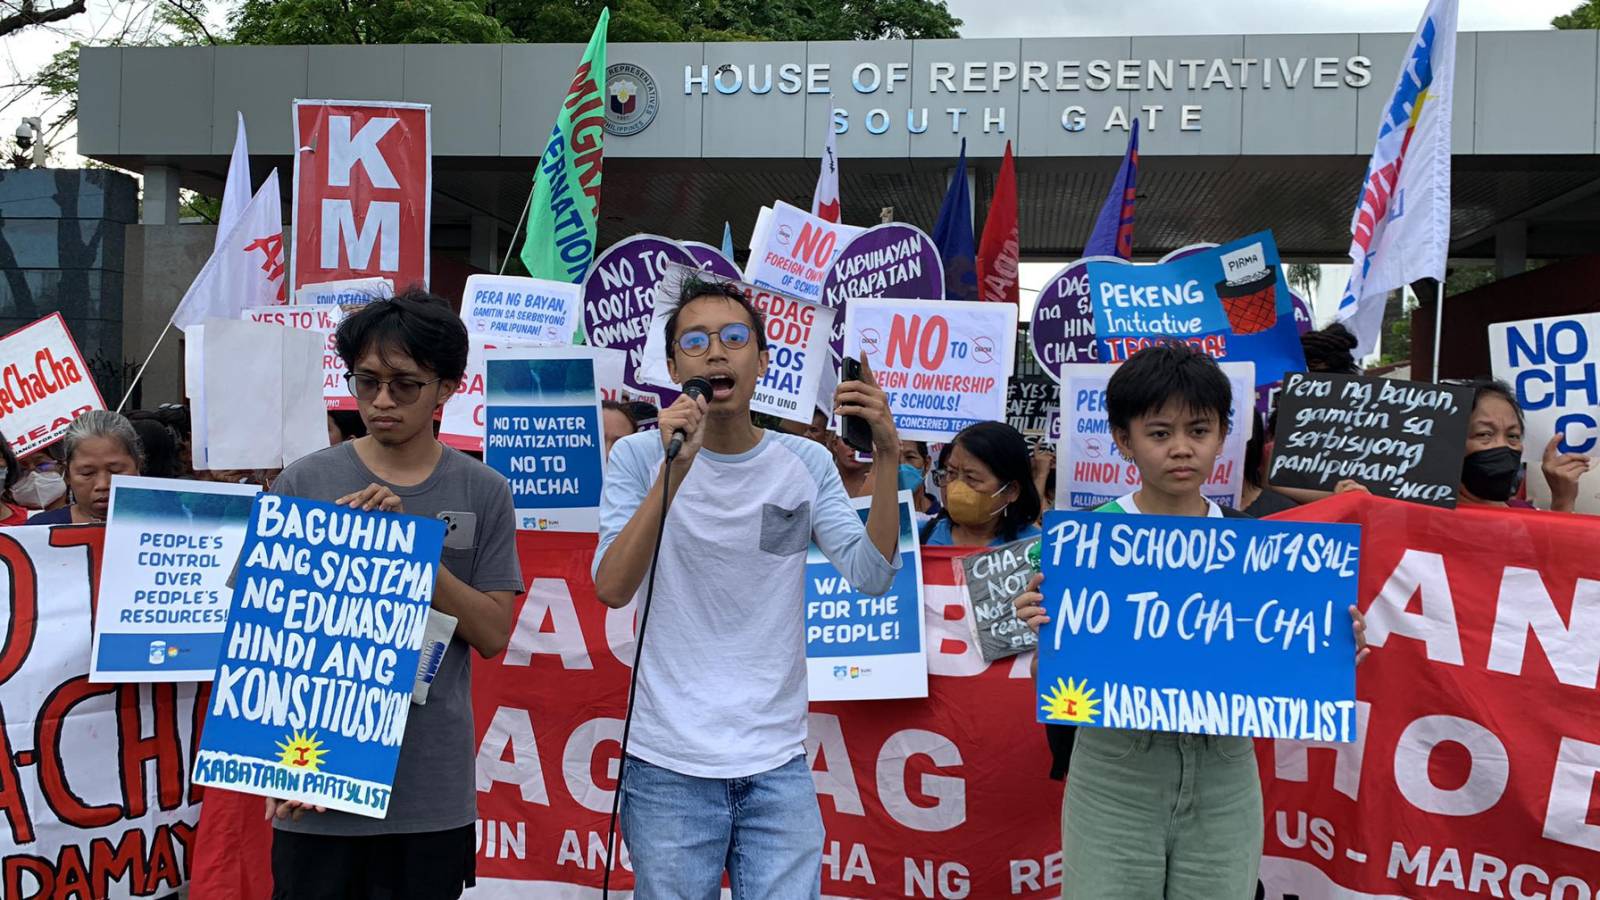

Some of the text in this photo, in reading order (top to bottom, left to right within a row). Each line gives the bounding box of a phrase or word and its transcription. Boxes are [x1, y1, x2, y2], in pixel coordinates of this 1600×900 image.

[684, 55, 1373, 94] HOUSE OF REPRESENTATIVES
[832, 104, 1201, 135] SOUTH GATE
[791, 222, 836, 268] NO
[835, 234, 922, 281] KABUHAYAN
[598, 250, 670, 291] NO TO
[764, 251, 805, 276] FOREIGN
[1228, 254, 1258, 272] PIRMA
[781, 275, 794, 286] OF
[827, 256, 922, 307] KARAPATAN
[475, 290, 567, 315] PERA NG BAYAN,
[1100, 280, 1204, 308] PEKENG
[290, 312, 313, 329] TO
[473, 307, 565, 326] GAMITIN SA SERBISYONG
[586, 290, 634, 327] 100%
[1039, 304, 1061, 321] na
[490, 321, 542, 336] PANLIPUNAN!
[763, 318, 811, 349] OD!
[1106, 309, 1202, 334] Initiative
[885, 313, 967, 371] NO TO
[1506, 320, 1588, 367] NO
[912, 373, 994, 394] OWNERSHIP
[1020, 382, 1047, 399] YES
[1285, 374, 1459, 415] Pera ng bayan,
[777, 398, 797, 410] UNO
[901, 393, 961, 412] SCHOOLS!
[494, 417, 586, 430] NO TO WATER
[900, 416, 949, 429] CONCERNED
[1077, 418, 1110, 434] GAMI
[1295, 400, 1389, 429] gamitin
[1402, 417, 1434, 436] sa
[489, 434, 595, 448] PRIVATIZATION.
[1285, 426, 1425, 468] serbisyong
[510, 456, 566, 473] NO TO
[1074, 462, 1120, 484] HINDI
[1269, 451, 1409, 486] panlipunan!
[508, 478, 579, 495] HACHA!
[256, 495, 416, 554] BAGUHIN
[140, 532, 223, 550] PEOPLE'S
[1048, 520, 1101, 569] PH
[1110, 524, 1238, 574] SCHOOLS
[1243, 532, 1289, 575] NOT
[1301, 533, 1359, 577] SALE
[138, 552, 220, 568] CONTROL
[245, 541, 433, 603] ANG SISTEMA
[155, 571, 202, 586] OVER
[988, 568, 1031, 601] NOT
[134, 590, 218, 605] PEOPLE'S
[808, 595, 899, 619] FOR THE
[120, 609, 228, 624] RESOURCES!
[241, 576, 430, 651] NG EDUKASYON
[1054, 587, 1110, 650] NO
[1125, 590, 1170, 640] TO
[1176, 593, 1333, 654] CHA-CHA!
[808, 621, 900, 644] PEOPLE!
[228, 622, 316, 671] HINDI
[320, 641, 397, 686] ANG
[213, 664, 413, 747] KONSTITUSYON
[1103, 681, 1355, 743] KABATAAN PARTYLIST
[195, 755, 391, 810] KABATAAN PARTYLIST
[904, 857, 970, 899] NG
[1276, 811, 1335, 860] US
